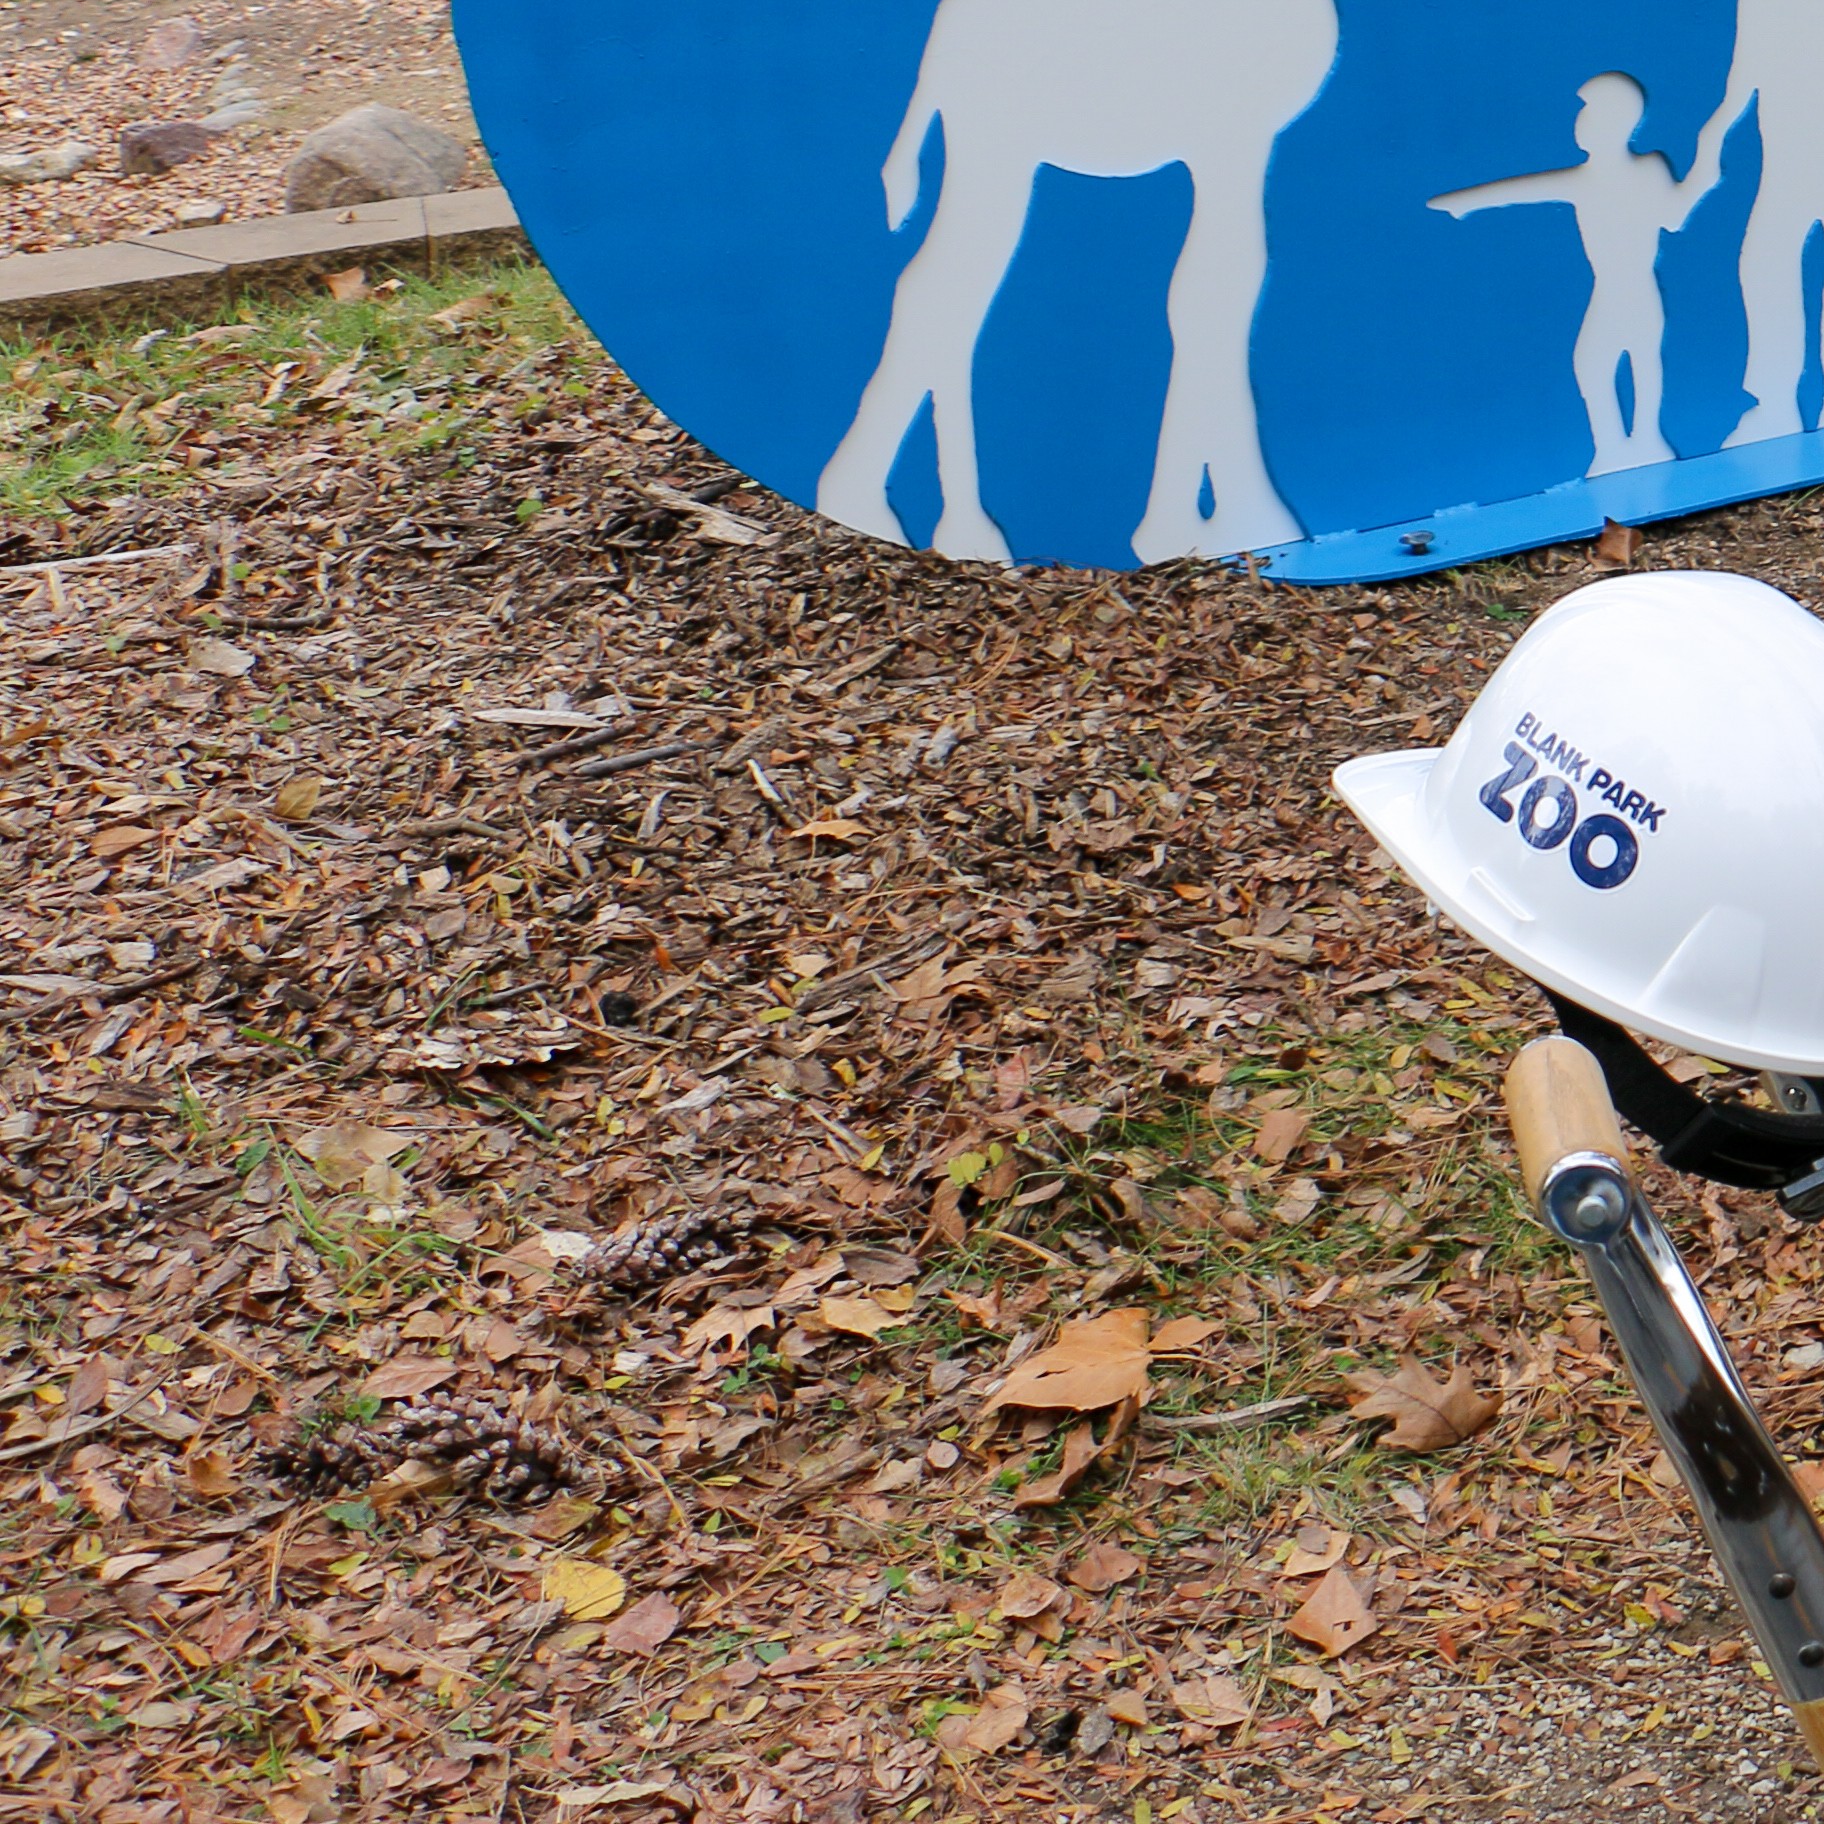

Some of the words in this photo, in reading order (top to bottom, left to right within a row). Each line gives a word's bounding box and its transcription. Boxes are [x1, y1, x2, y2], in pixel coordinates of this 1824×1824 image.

[1479, 740, 1639, 890] ZOO
[1514, 711, 1590, 782] BLANK
[1587, 767, 1667, 833] PARK
